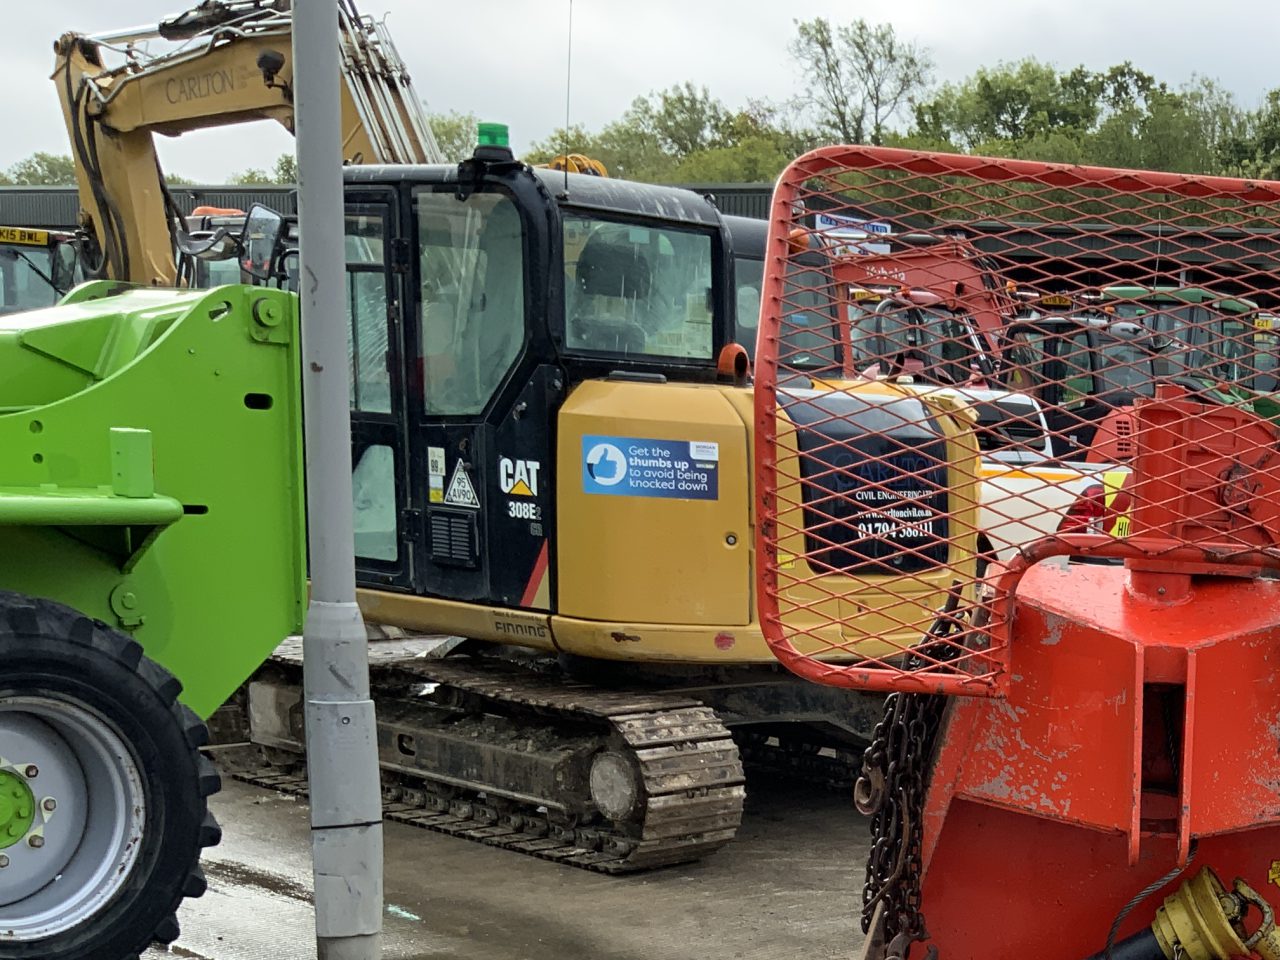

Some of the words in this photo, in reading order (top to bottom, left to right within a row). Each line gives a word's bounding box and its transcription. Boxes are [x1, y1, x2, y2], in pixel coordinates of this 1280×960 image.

[166, 68, 234, 104] CARLTON
[628, 445, 649, 456] Get
[651, 446, 671, 458] the
[629, 457, 672, 468] thumbs
[674, 461, 689, 472] up
[456, 477, 466, 489] 95
[500, 458, 540, 497] CAT
[629, 468, 641, 477] to
[643, 468, 674, 479] avoid
[677, 470, 708, 483] being
[629, 478, 675, 489] knocked
[677, 481, 708, 491] down
[855, 491, 876, 500] CIVIL
[858, 522, 896, 539] 01794
